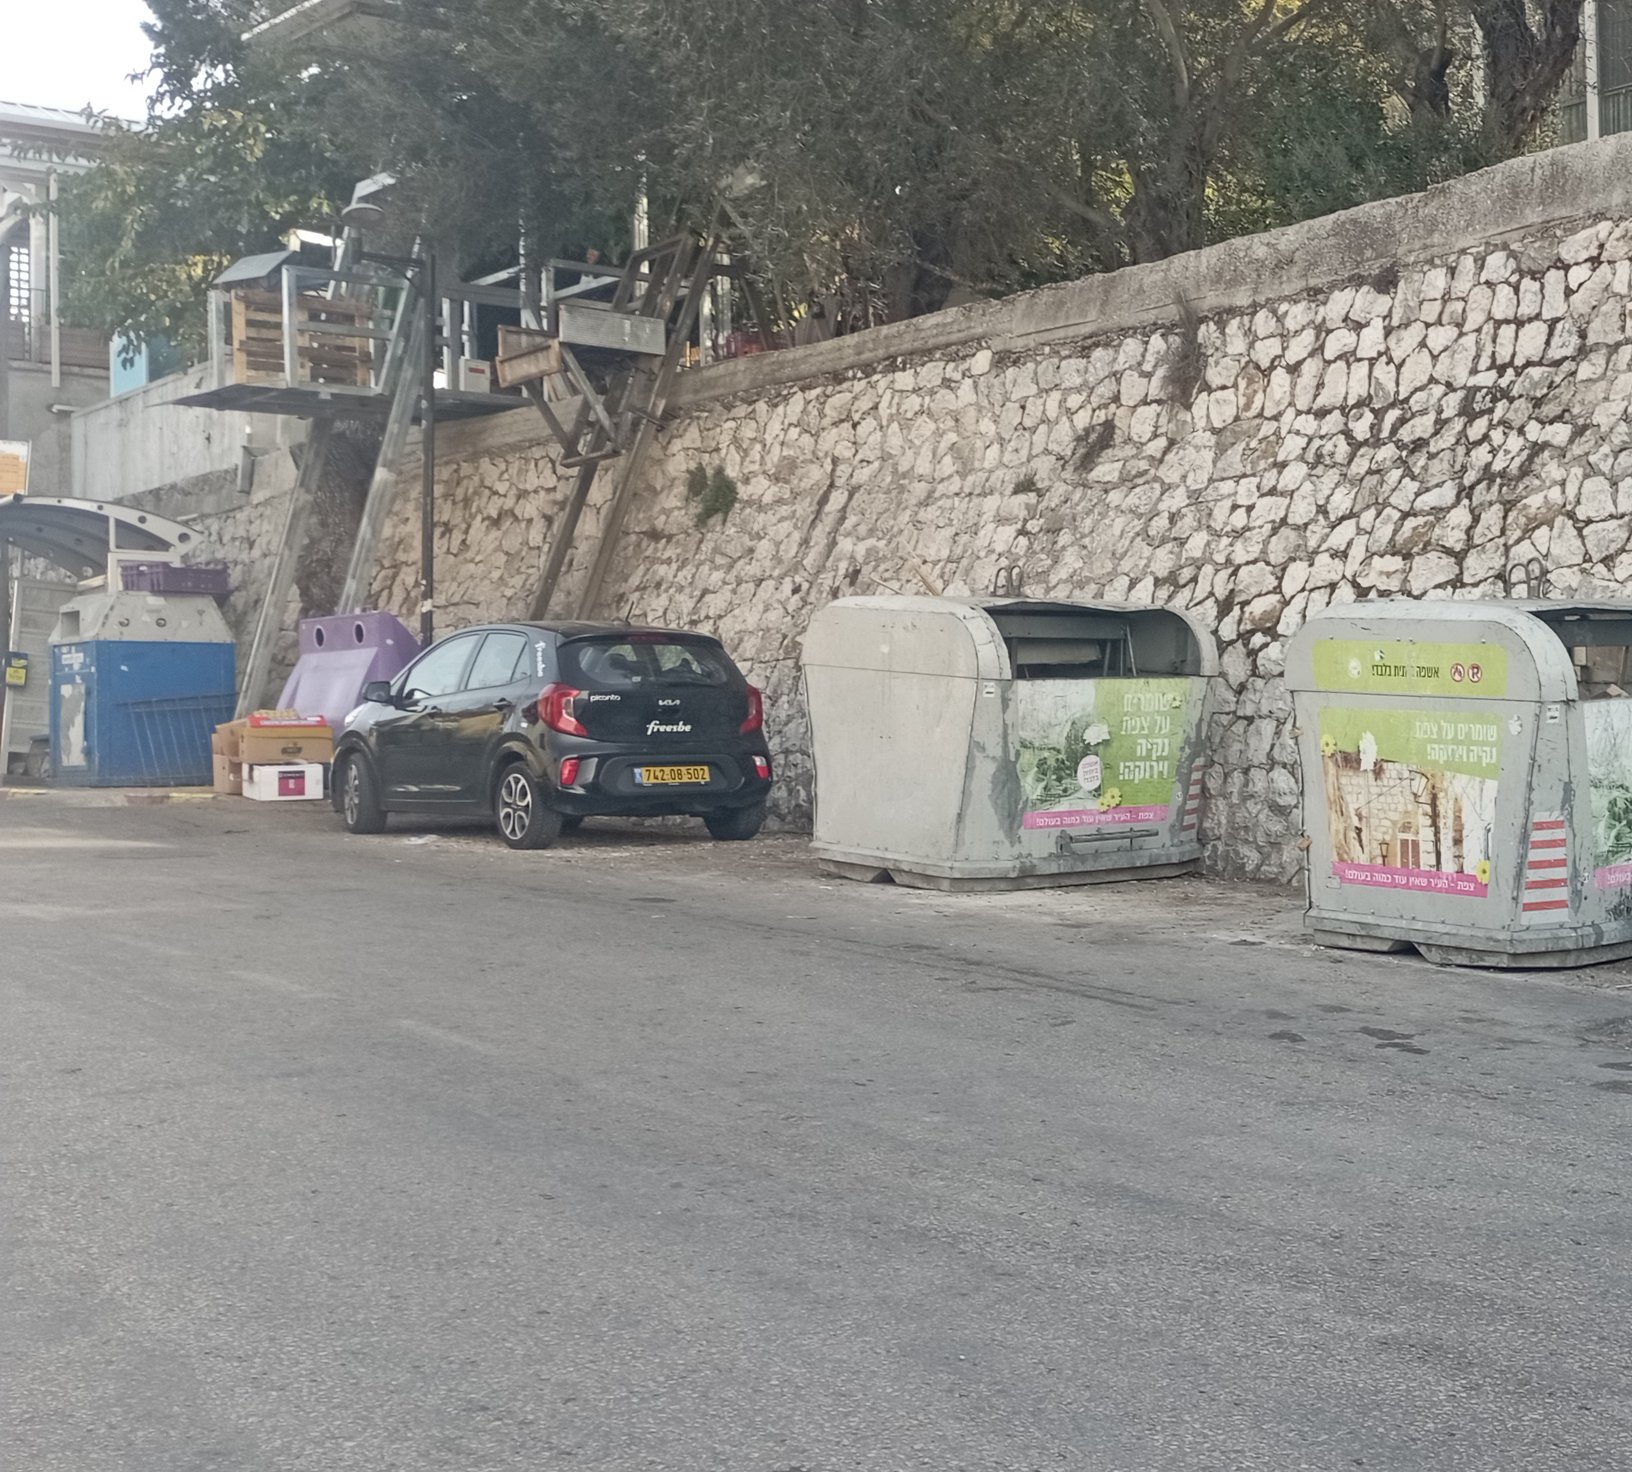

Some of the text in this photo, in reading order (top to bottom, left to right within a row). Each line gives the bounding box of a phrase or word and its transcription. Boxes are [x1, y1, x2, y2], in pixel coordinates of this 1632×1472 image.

[1415, 665, 1440, 678] אשפה
[645, 720, 692, 735] freesbe
[1120, 713, 1170, 736] על צפת
[1415, 719, 1497, 741] שומרים על צפת
[1136, 737, 1169, 761] נקיה
[1470, 745, 1497, 767] נקיה
[1118, 760, 1169, 784] וירוקה!
[1345, 869, 1371, 881] בעולם!
[1373, 872, 1391, 883] כמוה
[1393, 874, 1407, 884] עוד
[1409, 876, 1427, 886] שאין
[1430, 878, 1449, 888] העיר
[1457, 880, 1475, 891] צפת
